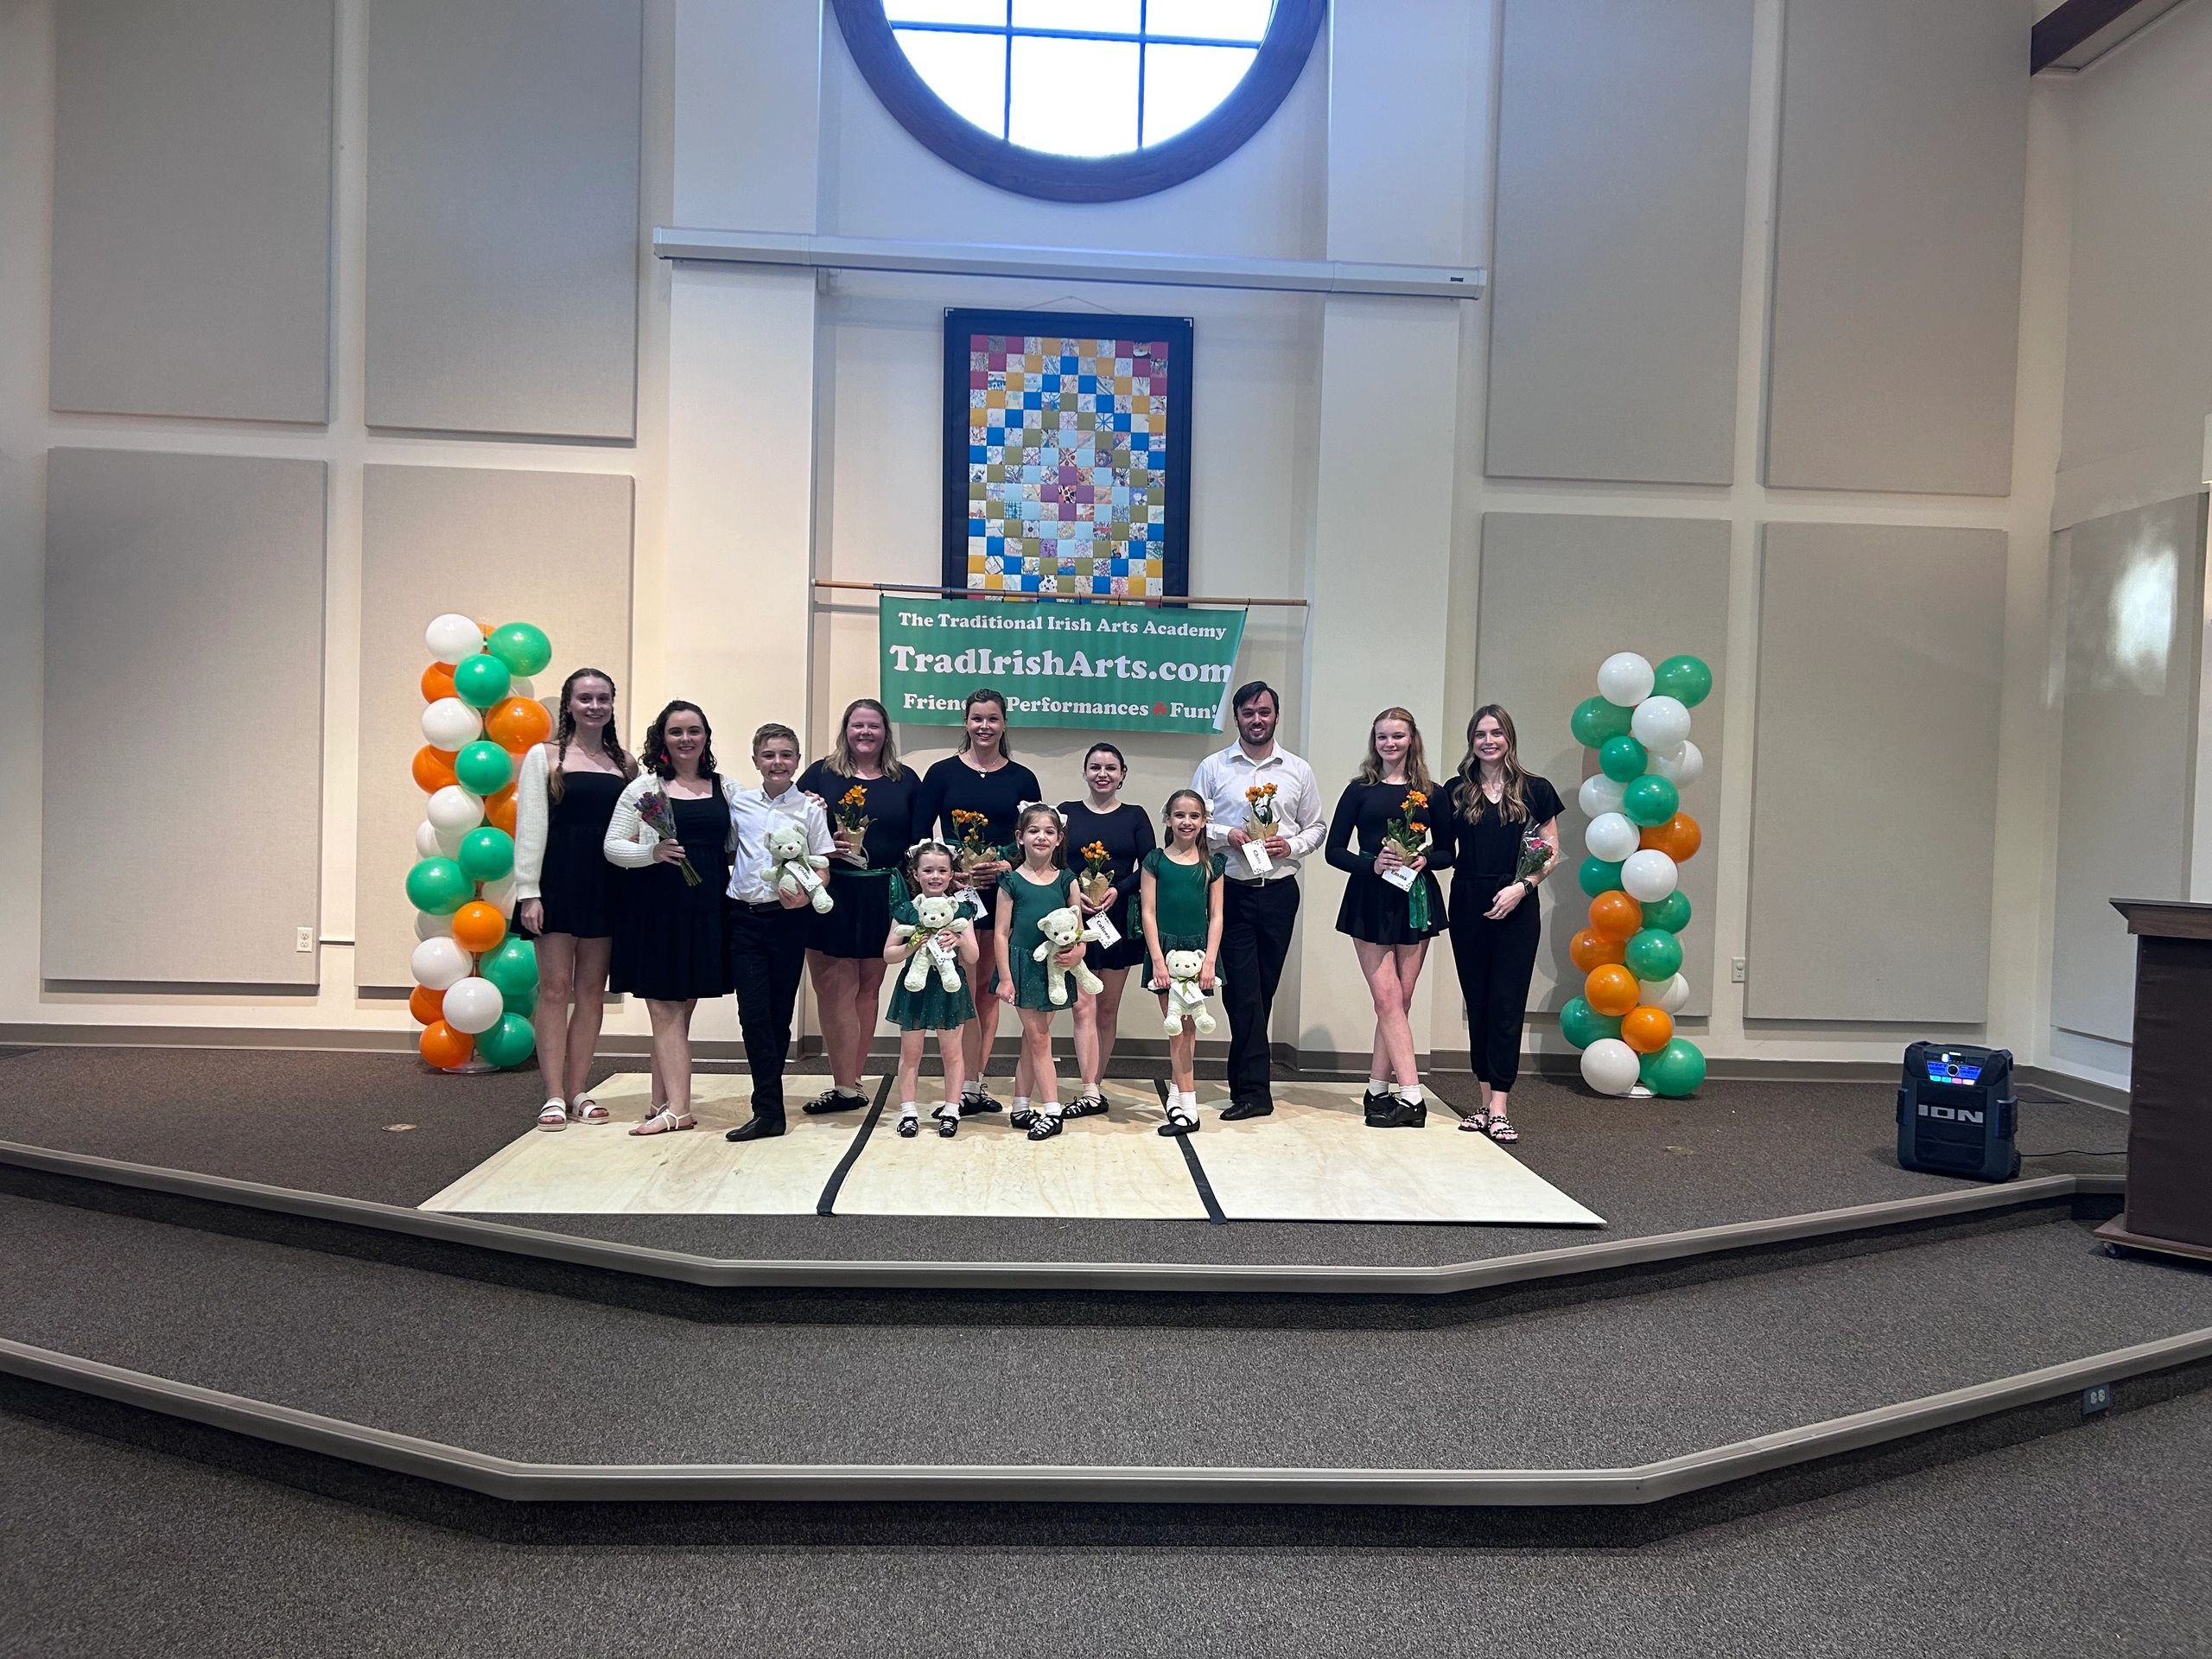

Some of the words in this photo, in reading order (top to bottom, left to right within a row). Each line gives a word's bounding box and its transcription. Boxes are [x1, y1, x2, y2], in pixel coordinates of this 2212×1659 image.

[898, 612, 934, 628] The
[938, 613, 1042, 631] Traditional
[1048, 616, 1091, 632] Irish
[1096, 618, 1139, 634] Arts
[1143, 620, 1227, 641] Academy
[889, 645, 1232, 683] TradIrishArts.com
[1006, 696, 1149, 717] Performances
[1169, 702, 1217, 719] Fun!
[1096, 919, 1111, 940] Colleen
[1917, 1103, 1984, 1124] ION
